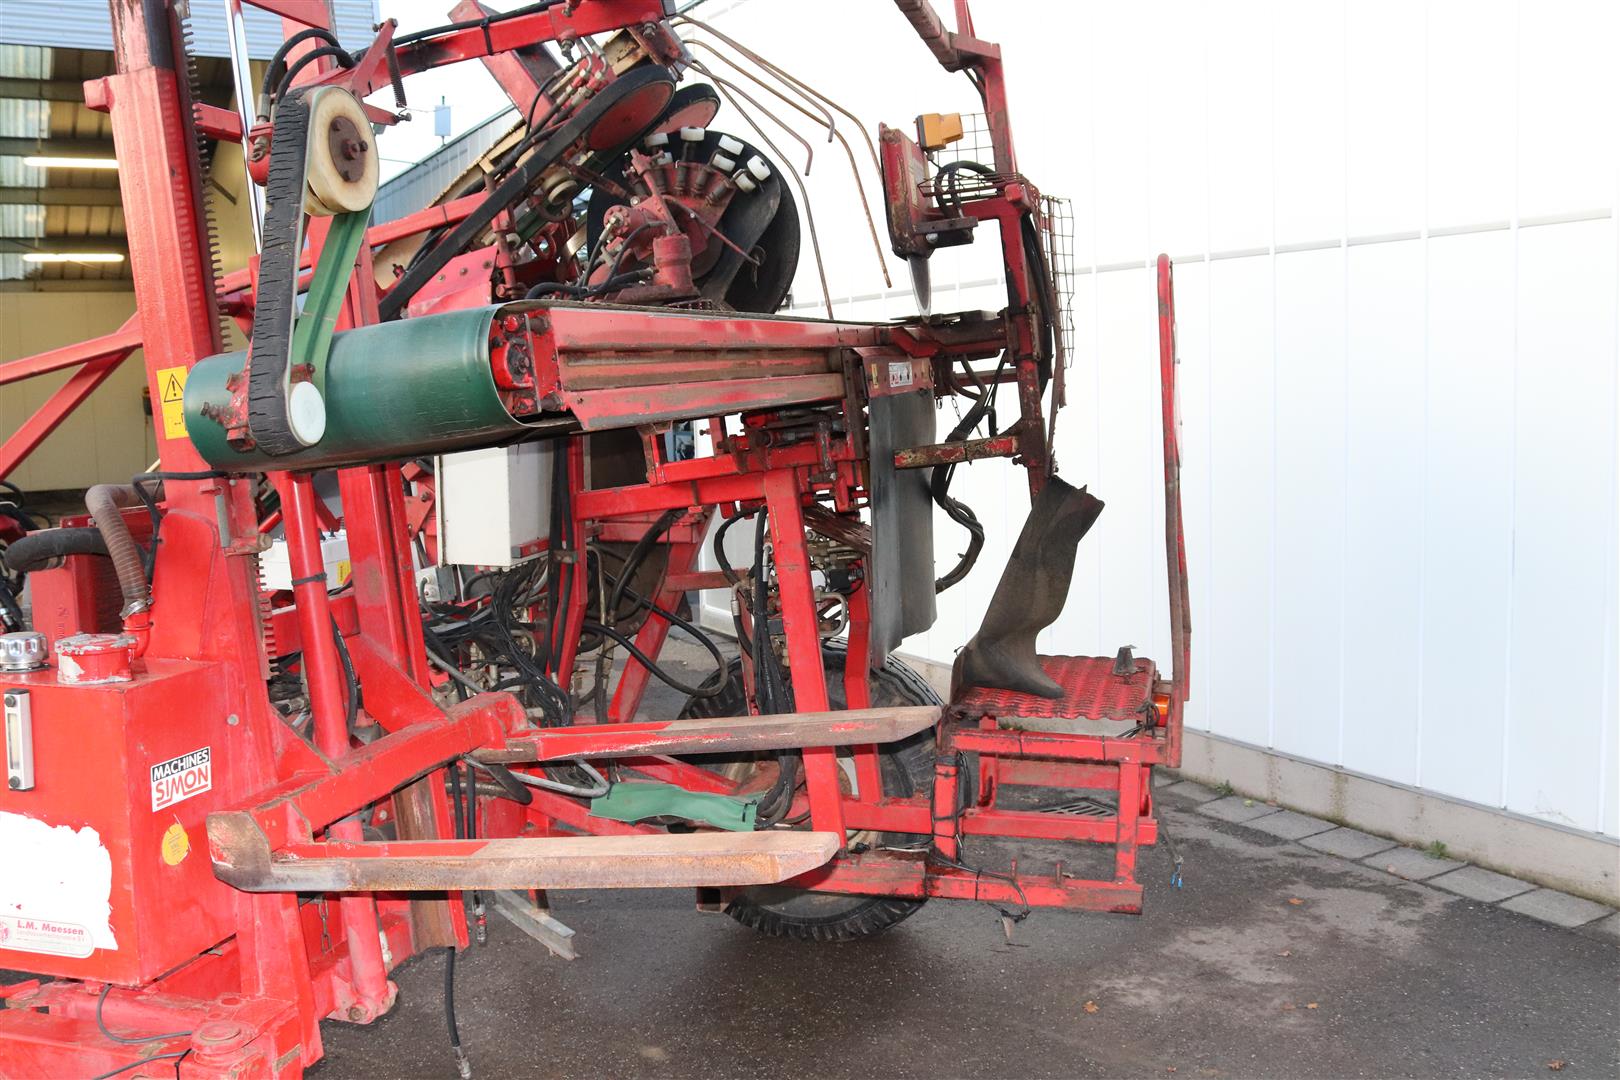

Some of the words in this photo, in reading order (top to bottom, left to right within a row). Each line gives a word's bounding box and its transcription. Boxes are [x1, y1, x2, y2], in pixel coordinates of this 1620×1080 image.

[152, 749, 209, 781] MACHINES
[155, 765, 209, 807] SIMON
[17, 919, 38, 930] L.M.
[42, 923, 84, 936] Maessen
